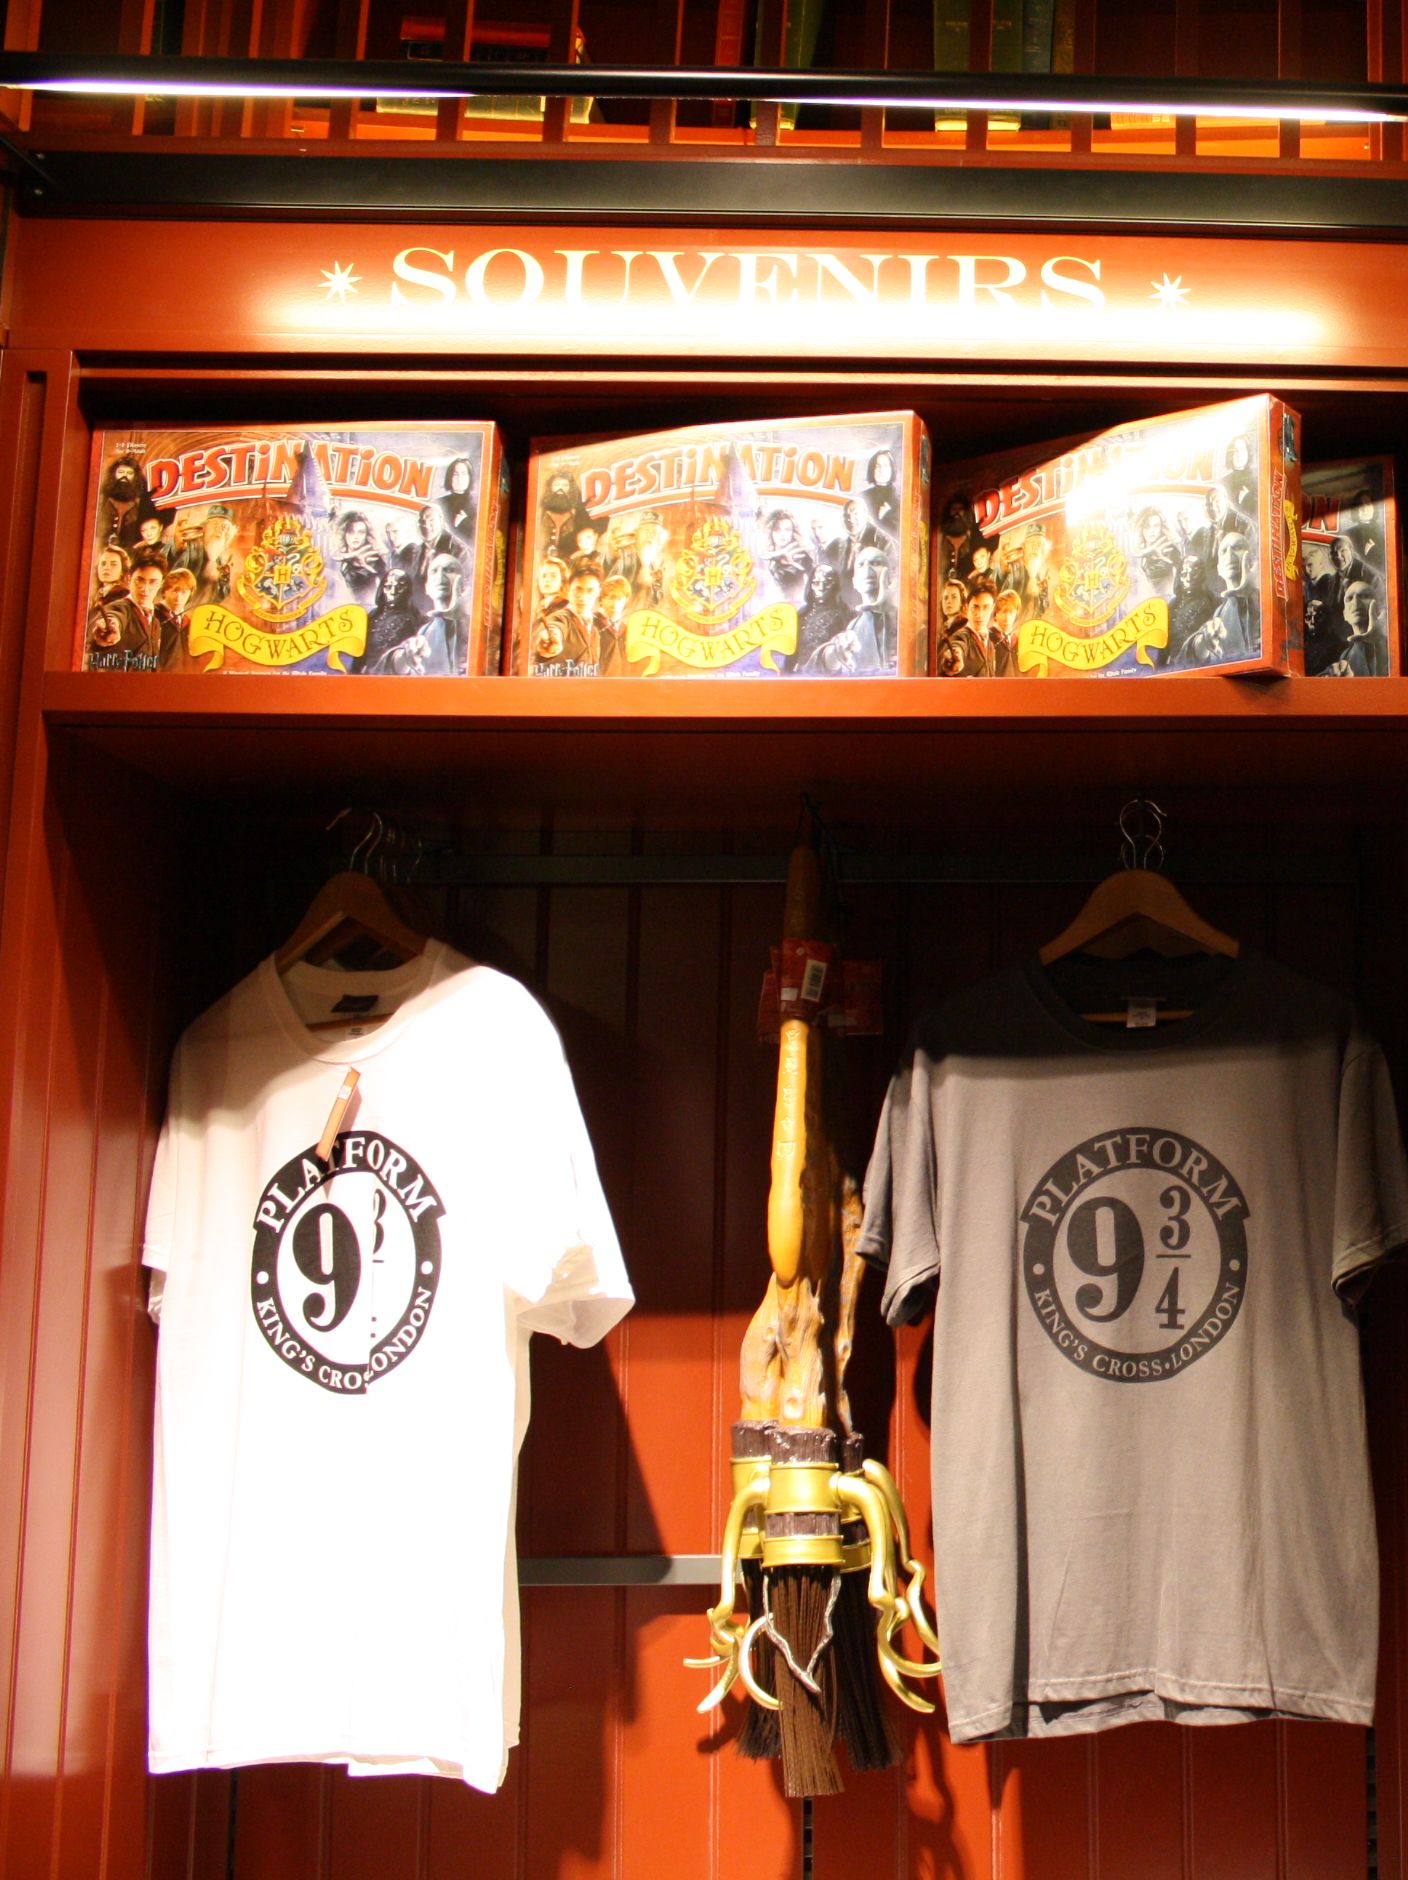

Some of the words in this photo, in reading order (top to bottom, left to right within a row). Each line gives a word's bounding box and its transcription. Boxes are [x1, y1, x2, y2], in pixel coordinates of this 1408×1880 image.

[390, 246, 1106, 313] SOUVENIRS
[204, 609, 353, 660] HOGWARTS
[641, 609, 784, 659] HOGWARTS
[1030, 603, 1157, 664] HOGWARTS
[1029, 1134, 1243, 1227] PLATFORM
[257, 1297, 315, 1372] KING'S
[366, 1286, 432, 1381] ONDON
[1034, 1289, 1088, 1361] KING'S
[1092, 1354, 1163, 1377] CROSS
[1170, 1282, 1241, 1370] LONDON
